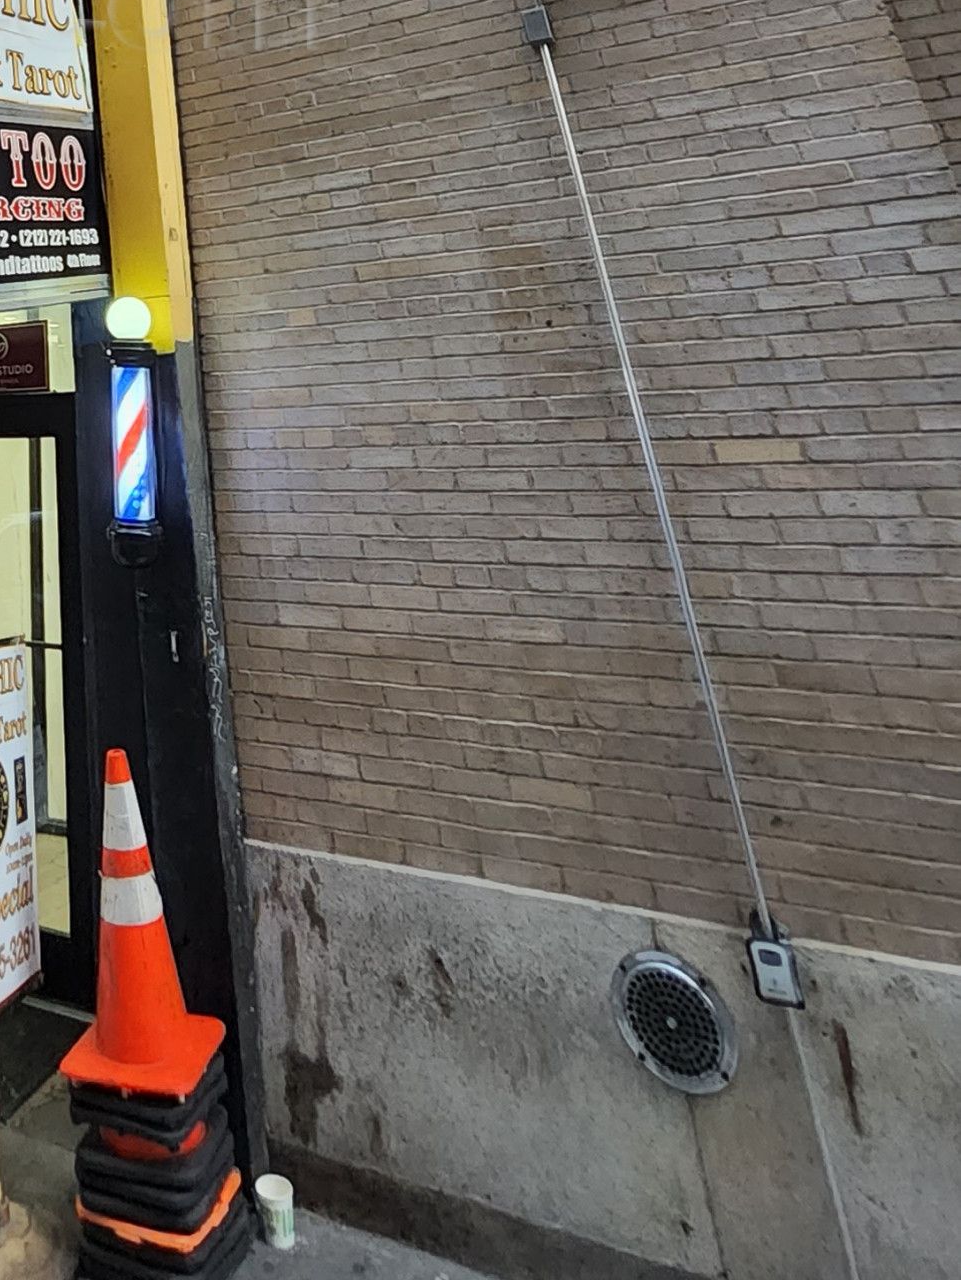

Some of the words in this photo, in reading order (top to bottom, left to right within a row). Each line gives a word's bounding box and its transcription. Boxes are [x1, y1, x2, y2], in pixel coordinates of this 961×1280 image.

[5, 48, 82, 100] Tarot
[18, 228, 48, 247] (212)
[48, 227, 99, 246] 221-1693
